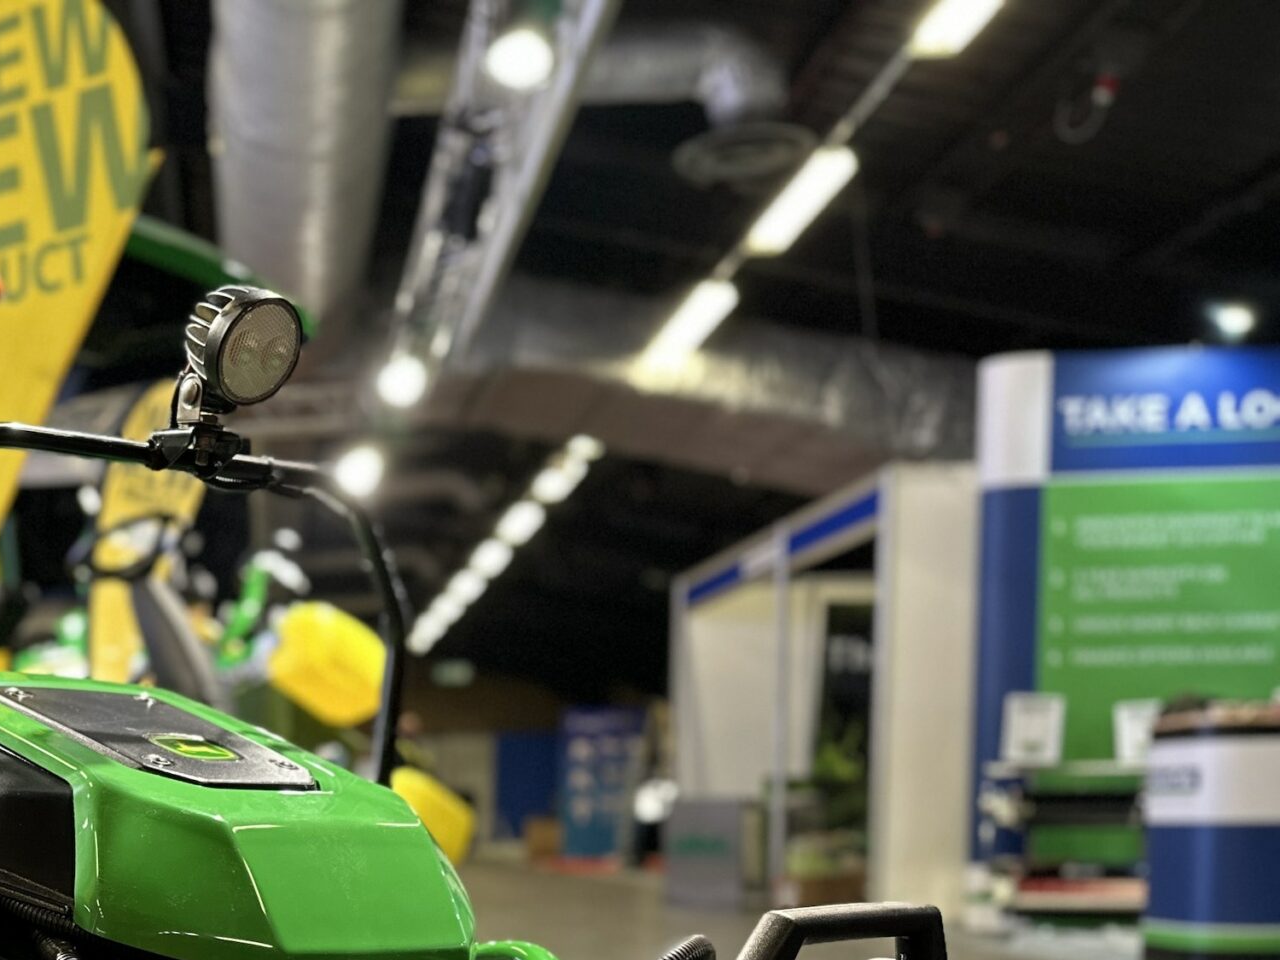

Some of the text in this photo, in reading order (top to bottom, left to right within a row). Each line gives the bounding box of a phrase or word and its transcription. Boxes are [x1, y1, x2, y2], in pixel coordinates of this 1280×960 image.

[1060, 387, 1280, 434] TAKE A LO
